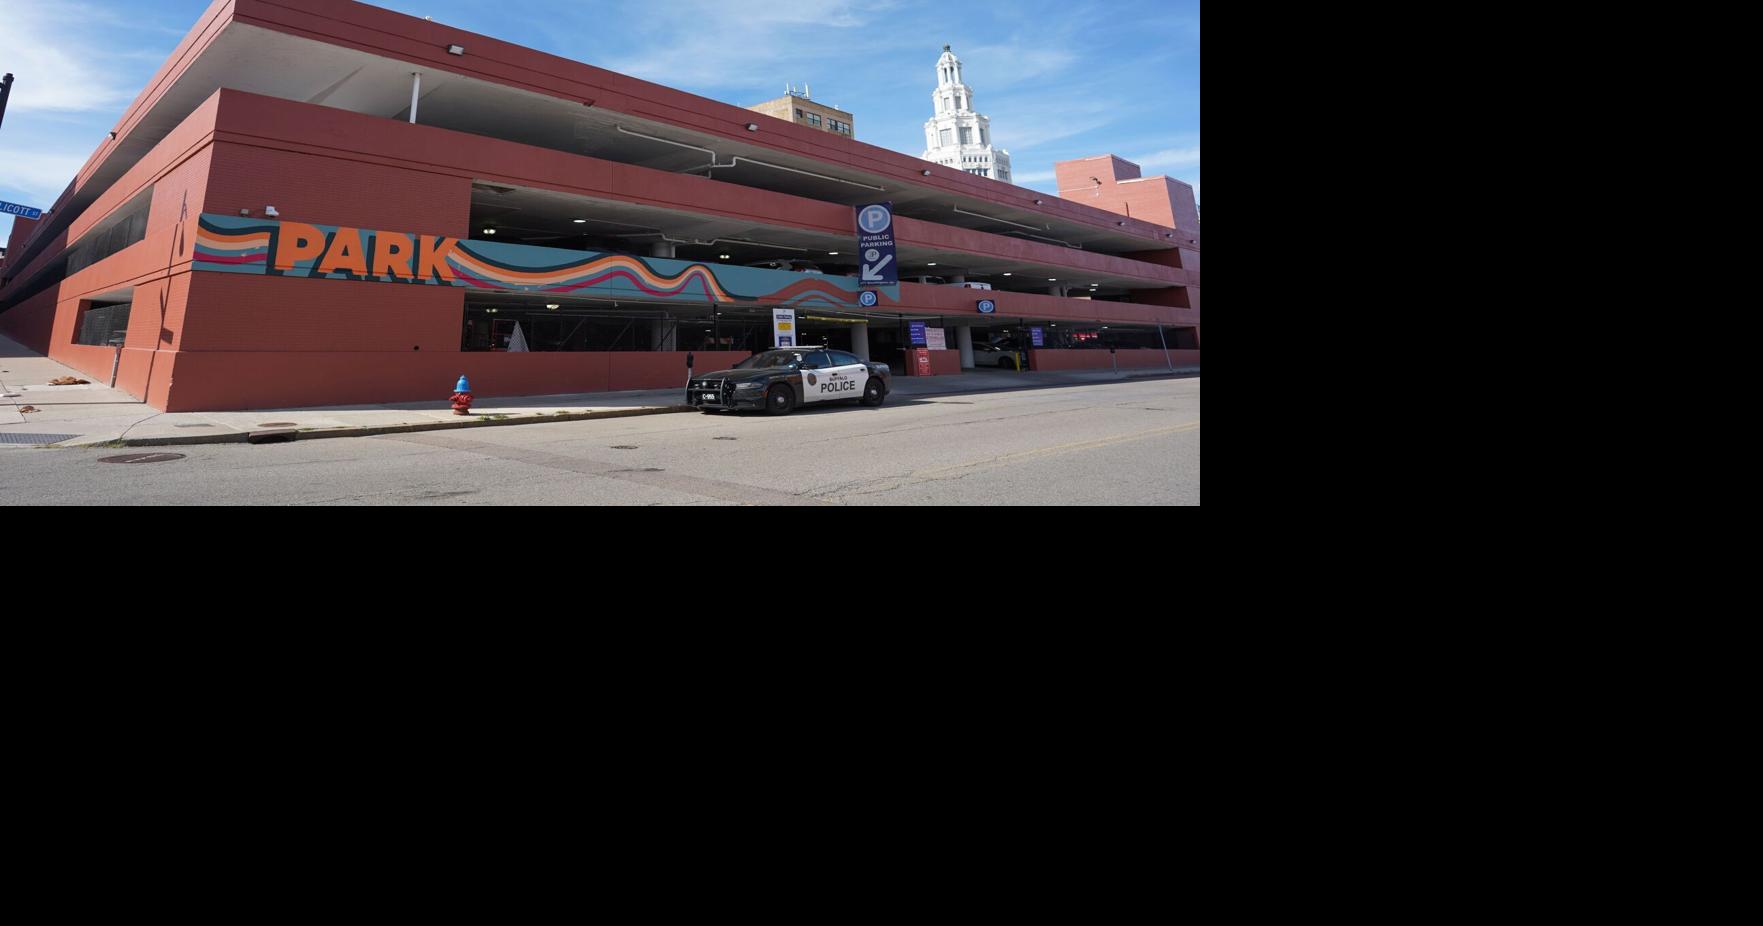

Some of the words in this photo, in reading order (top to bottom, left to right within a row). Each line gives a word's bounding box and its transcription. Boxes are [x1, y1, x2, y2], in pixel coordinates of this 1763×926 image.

[867, 210, 883, 228] P
[860, 240, 894, 249] PARKING
[274, 221, 460, 282] PARK
[864, 294, 873, 303] P
[982, 302, 991, 311] P
[820, 380, 856, 393] POLICE
